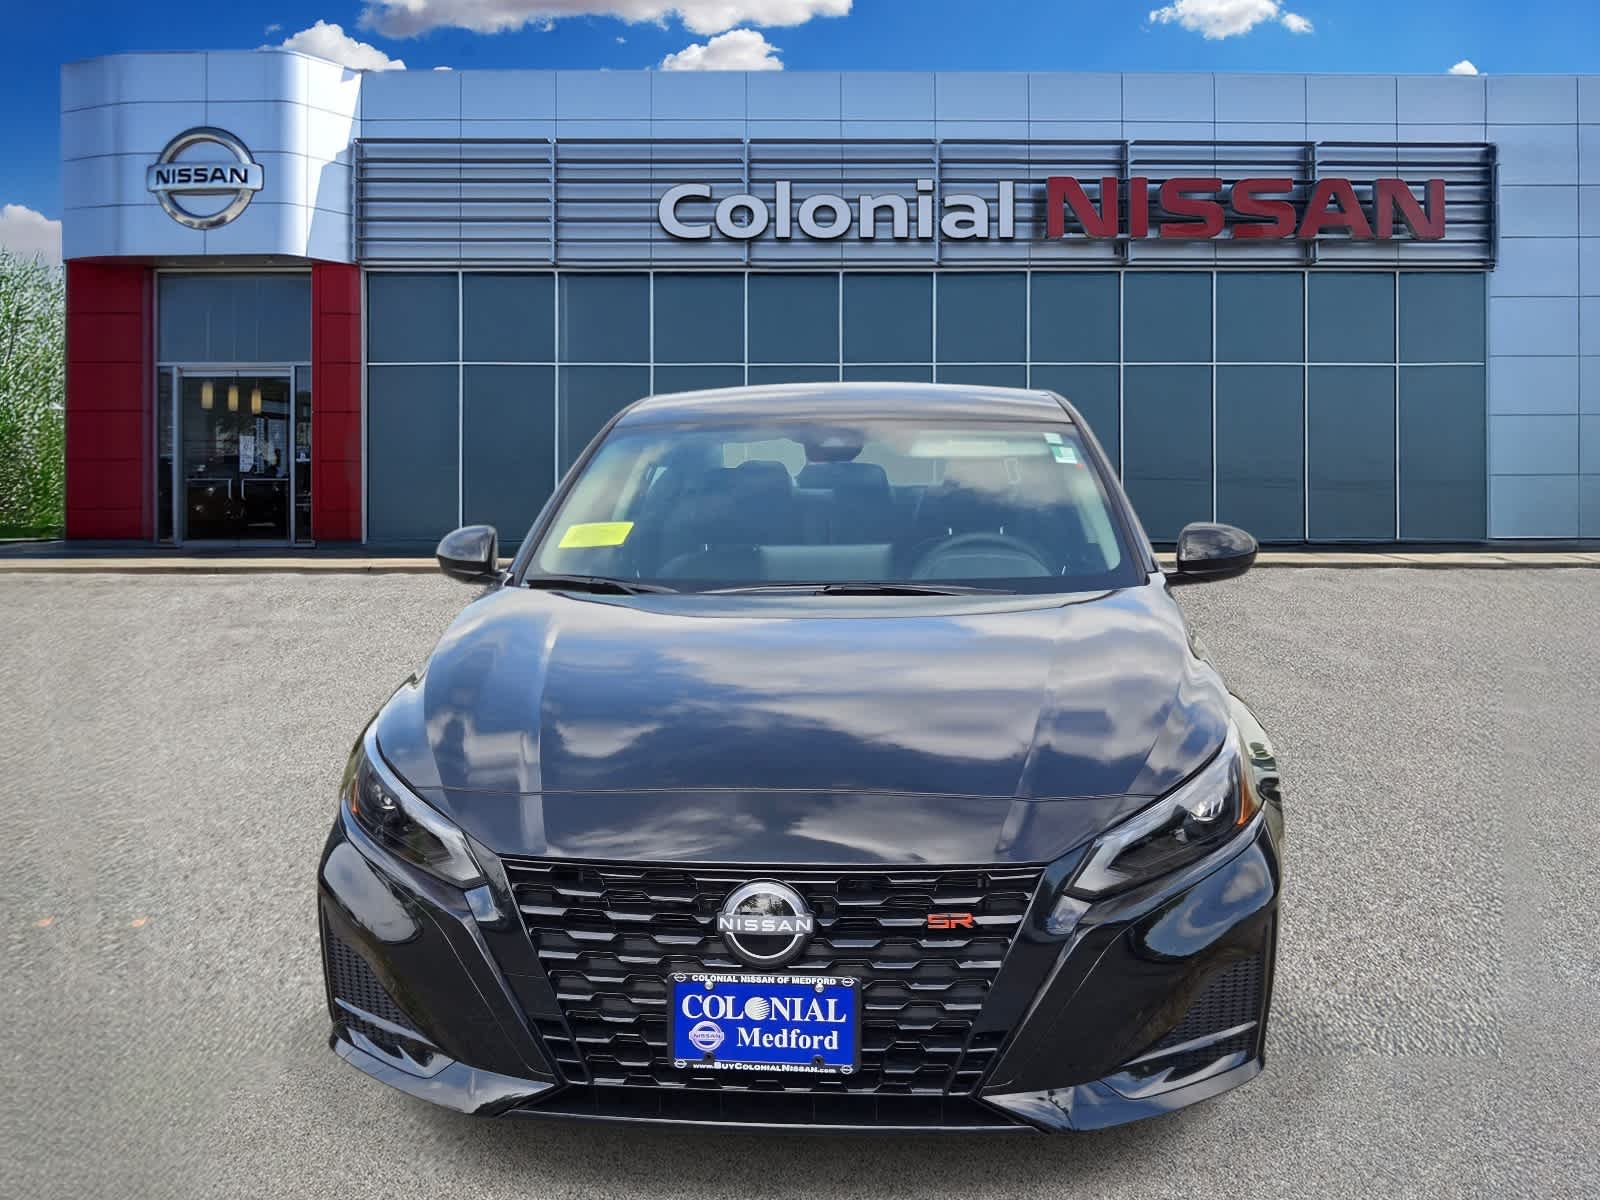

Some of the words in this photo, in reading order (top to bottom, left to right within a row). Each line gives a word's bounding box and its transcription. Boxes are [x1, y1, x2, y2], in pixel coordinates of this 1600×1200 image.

[155, 167, 249, 185] NISSAN
[658, 179, 1015, 239] Colonial
[1045, 176, 1446, 239] NISSAN
[719, 917, 812, 932] NISSAN
[927, 912, 975, 929] SR
[691, 974, 739, 983] COLONIAL
[740, 975, 775, 984] NISSAN
[791, 977, 837, 985] MEDFORD
[681, 994, 847, 1023] COLONIAL
[736, 1026, 839, 1050] Medford
